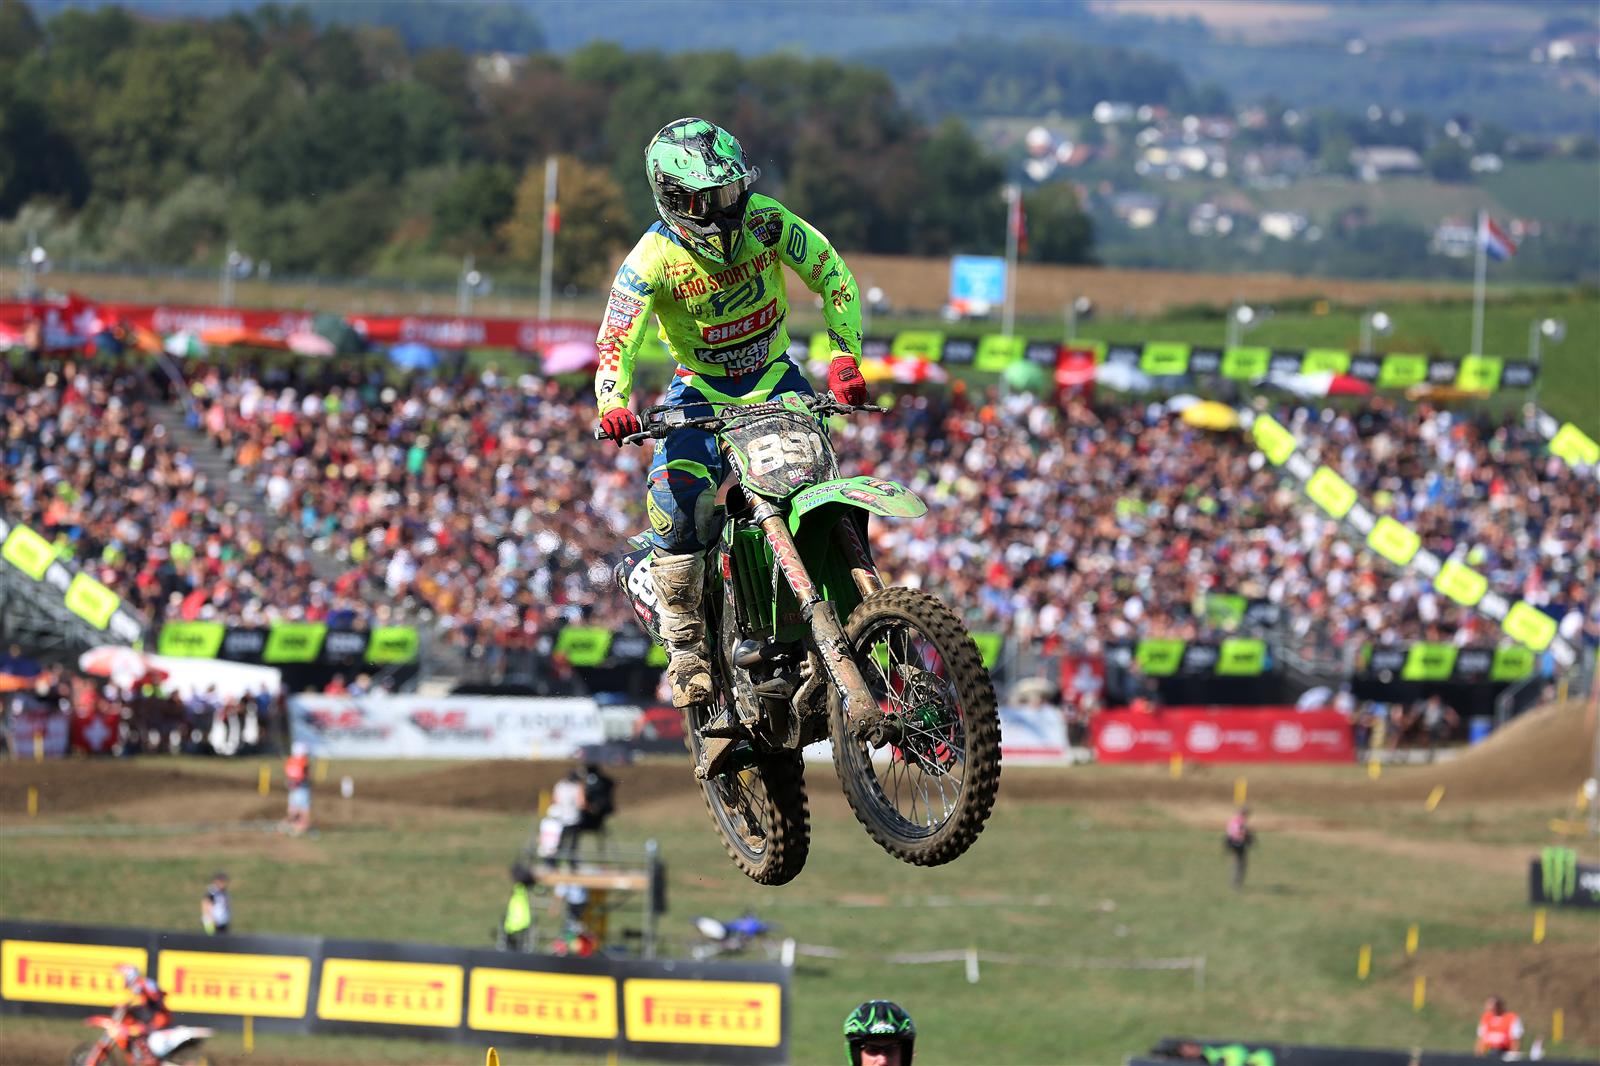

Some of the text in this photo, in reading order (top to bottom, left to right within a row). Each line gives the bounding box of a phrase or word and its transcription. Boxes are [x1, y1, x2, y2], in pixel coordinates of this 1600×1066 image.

[672, 278, 707, 302] AERO
[707, 262, 751, 293] SPORT
[708, 304, 775, 342] BIKE IT
[17, 956, 121, 992] PIRELL
[174, 966, 291, 1001] PIRELLI
[335, 976, 445, 1010] PIRELLI
[486, 985, 598, 1021] PIRELLI
[643, 996, 762, 1030] PIRELLI
